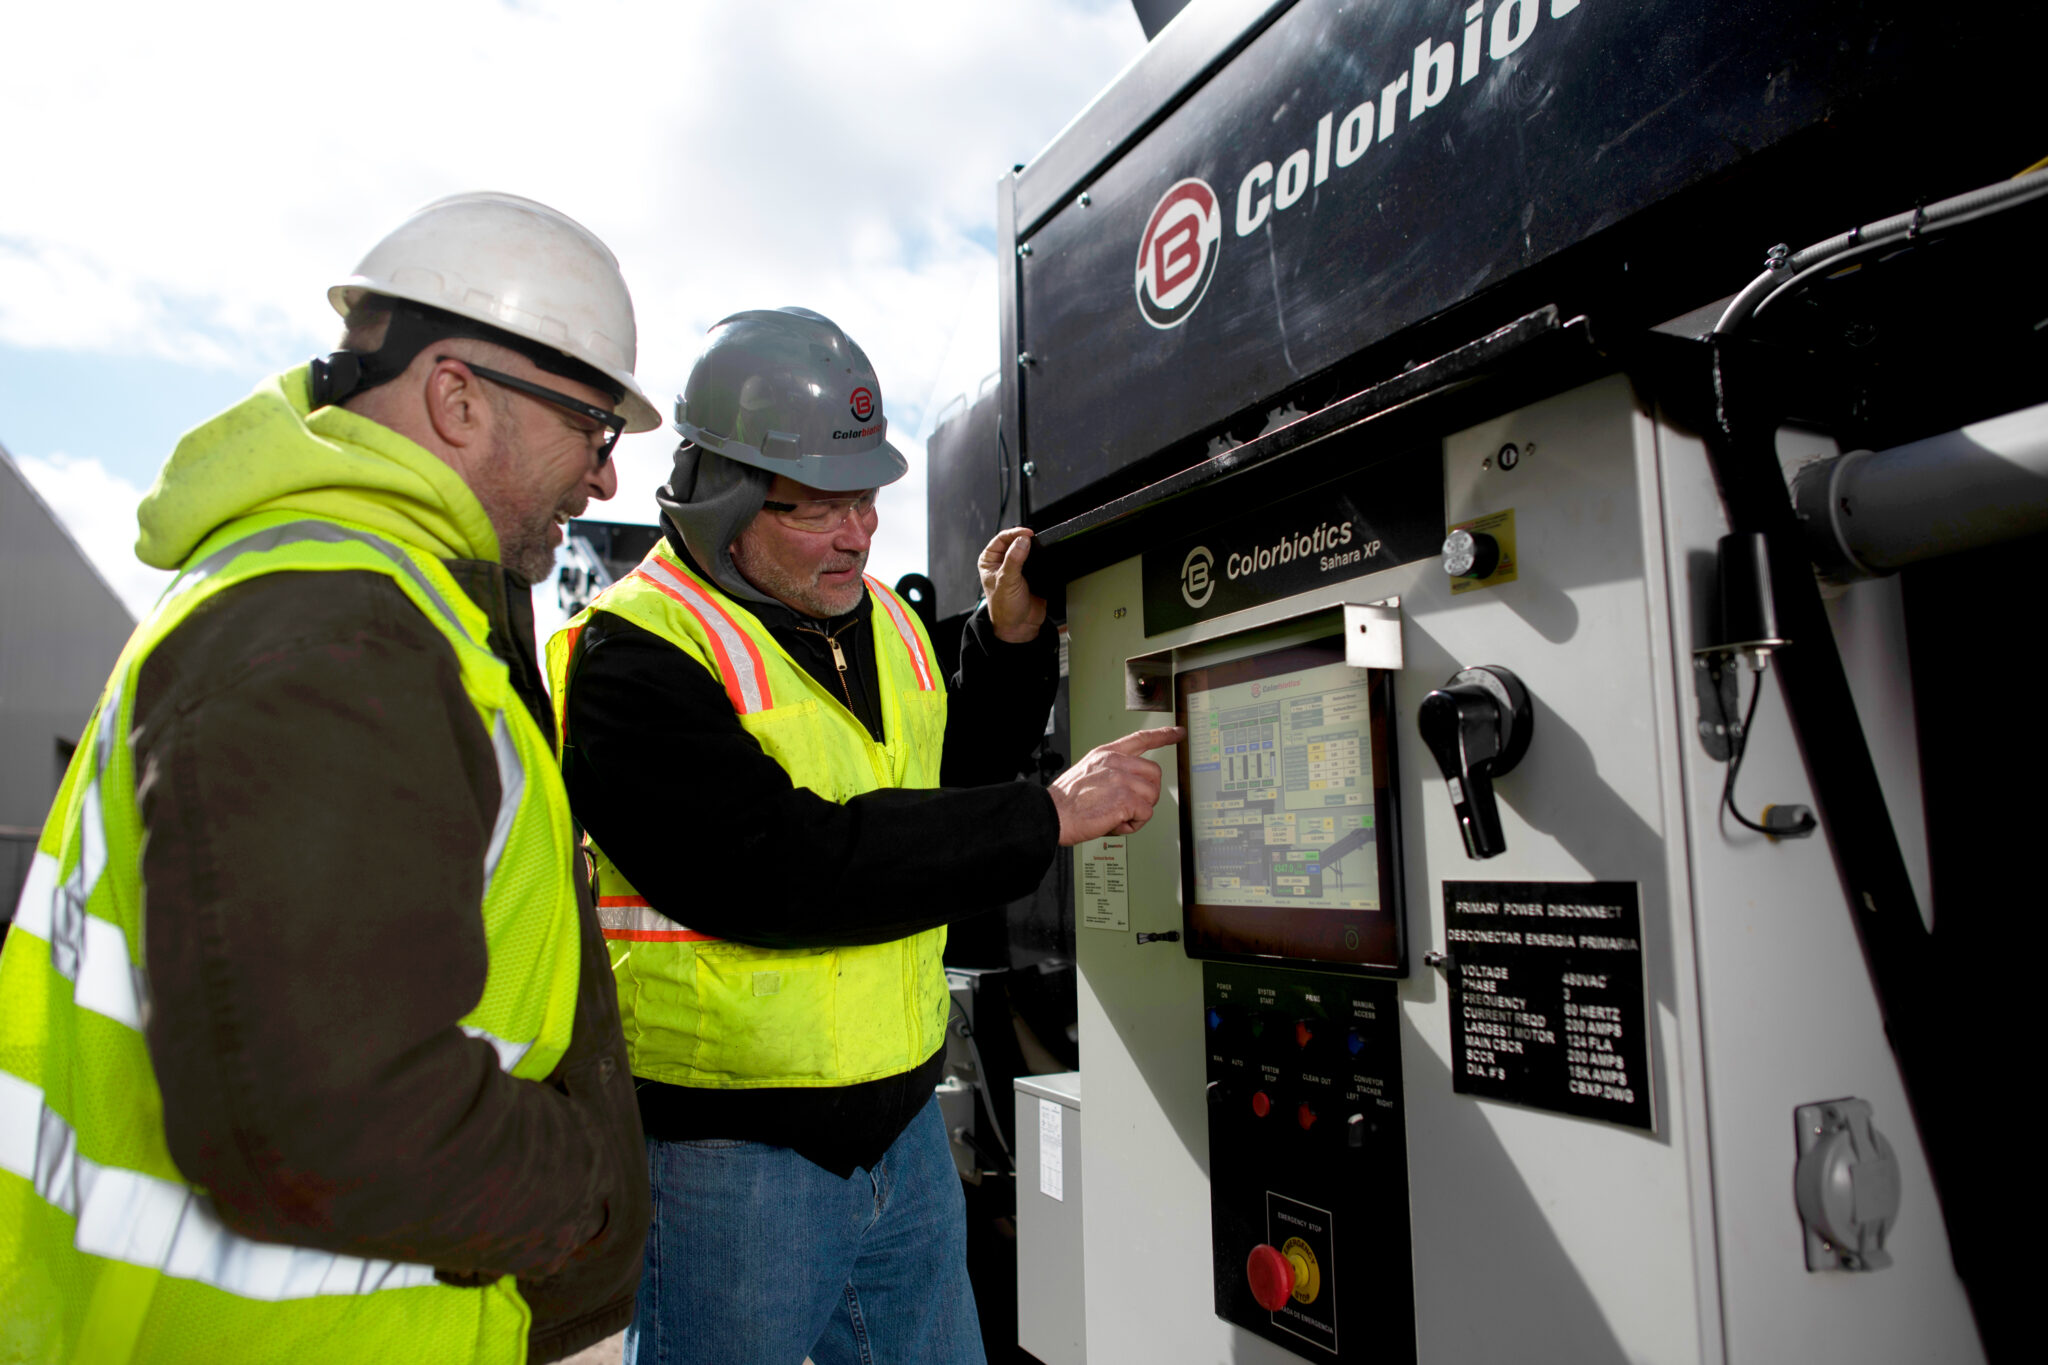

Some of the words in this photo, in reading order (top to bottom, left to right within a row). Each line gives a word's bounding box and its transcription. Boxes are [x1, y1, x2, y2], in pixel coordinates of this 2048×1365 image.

[1236, 0, 1582, 237] Colorbio
[1226, 521, 1353, 580] Colorbiotics
[1320, 549, 1361, 572] Sahara
[1363, 539, 1381, 560] XP
[1455, 901, 1500, 915] PRIMARY
[1503, 903, 1544, 917] POWER
[1547, 904, 1622, 919] DISCONNECT
[1447, 928, 1522, 945] DESCONECTAR
[1525, 932, 1576, 949] ENERGIA
[1579, 935, 1640, 951] PRIMARIA
[1461, 964, 1509, 980] VOLTAGE
[1216, 982, 1232, 991] POWER
[1257, 987, 1276, 997] SYSTEM
[1462, 978, 1497, 993] PHASE
[1259, 996, 1275, 1006] START
[1463, 992, 1527, 1010] FREQUENCY
[1563, 987, 1571, 1001] 3
[1352, 999, 1376, 1010] MANUAL
[1353, 1010, 1376, 1020] ACCESS
[1463, 1006, 1512, 1023] CURRENT
[1515, 1012, 1546, 1028] REQD
[1580, 1004, 1621, 1022] HERTZ
[1464, 1020, 1511, 1037] LARGEST
[1514, 1027, 1556, 1044] MOTOR
[1565, 1018, 1586, 1033] 200
[1588, 1021, 1622, 1038] AMPS
[1465, 1034, 1491, 1050] MAIN
[1566, 1034, 1587, 1049] 124
[1589, 1036, 1613, 1052] FLA
[1231, 1058, 1244, 1067] AUTO
[1466, 1048, 1495, 1064] SCCR
[1567, 1048, 1588, 1064] 200
[1589, 1051, 1625, 1070] AMPS
[1261, 1064, 1280, 1074] SYSTEM
[1592, 1068, 1628, 1086] AMPS
[1264, 1074, 1277, 1083] STOP
[1302, 1073, 1320, 1084] CLEAN
[1320, 1076, 1332, 1085] OUT
[1353, 1074, 1384, 1087] CONVEYOR
[1346, 1092, 1360, 1102] LEFT
[1356, 1085, 1382, 1097] STACKER
[1376, 1098, 1393, 1109] RIGHT
[1277, 1211, 1307, 1228] EMERGENCY
[1308, 1222, 1322, 1233] STOP
[1284, 1238, 1316, 1265] EMERGENCY
[1295, 1290, 1310, 1302] STOP
